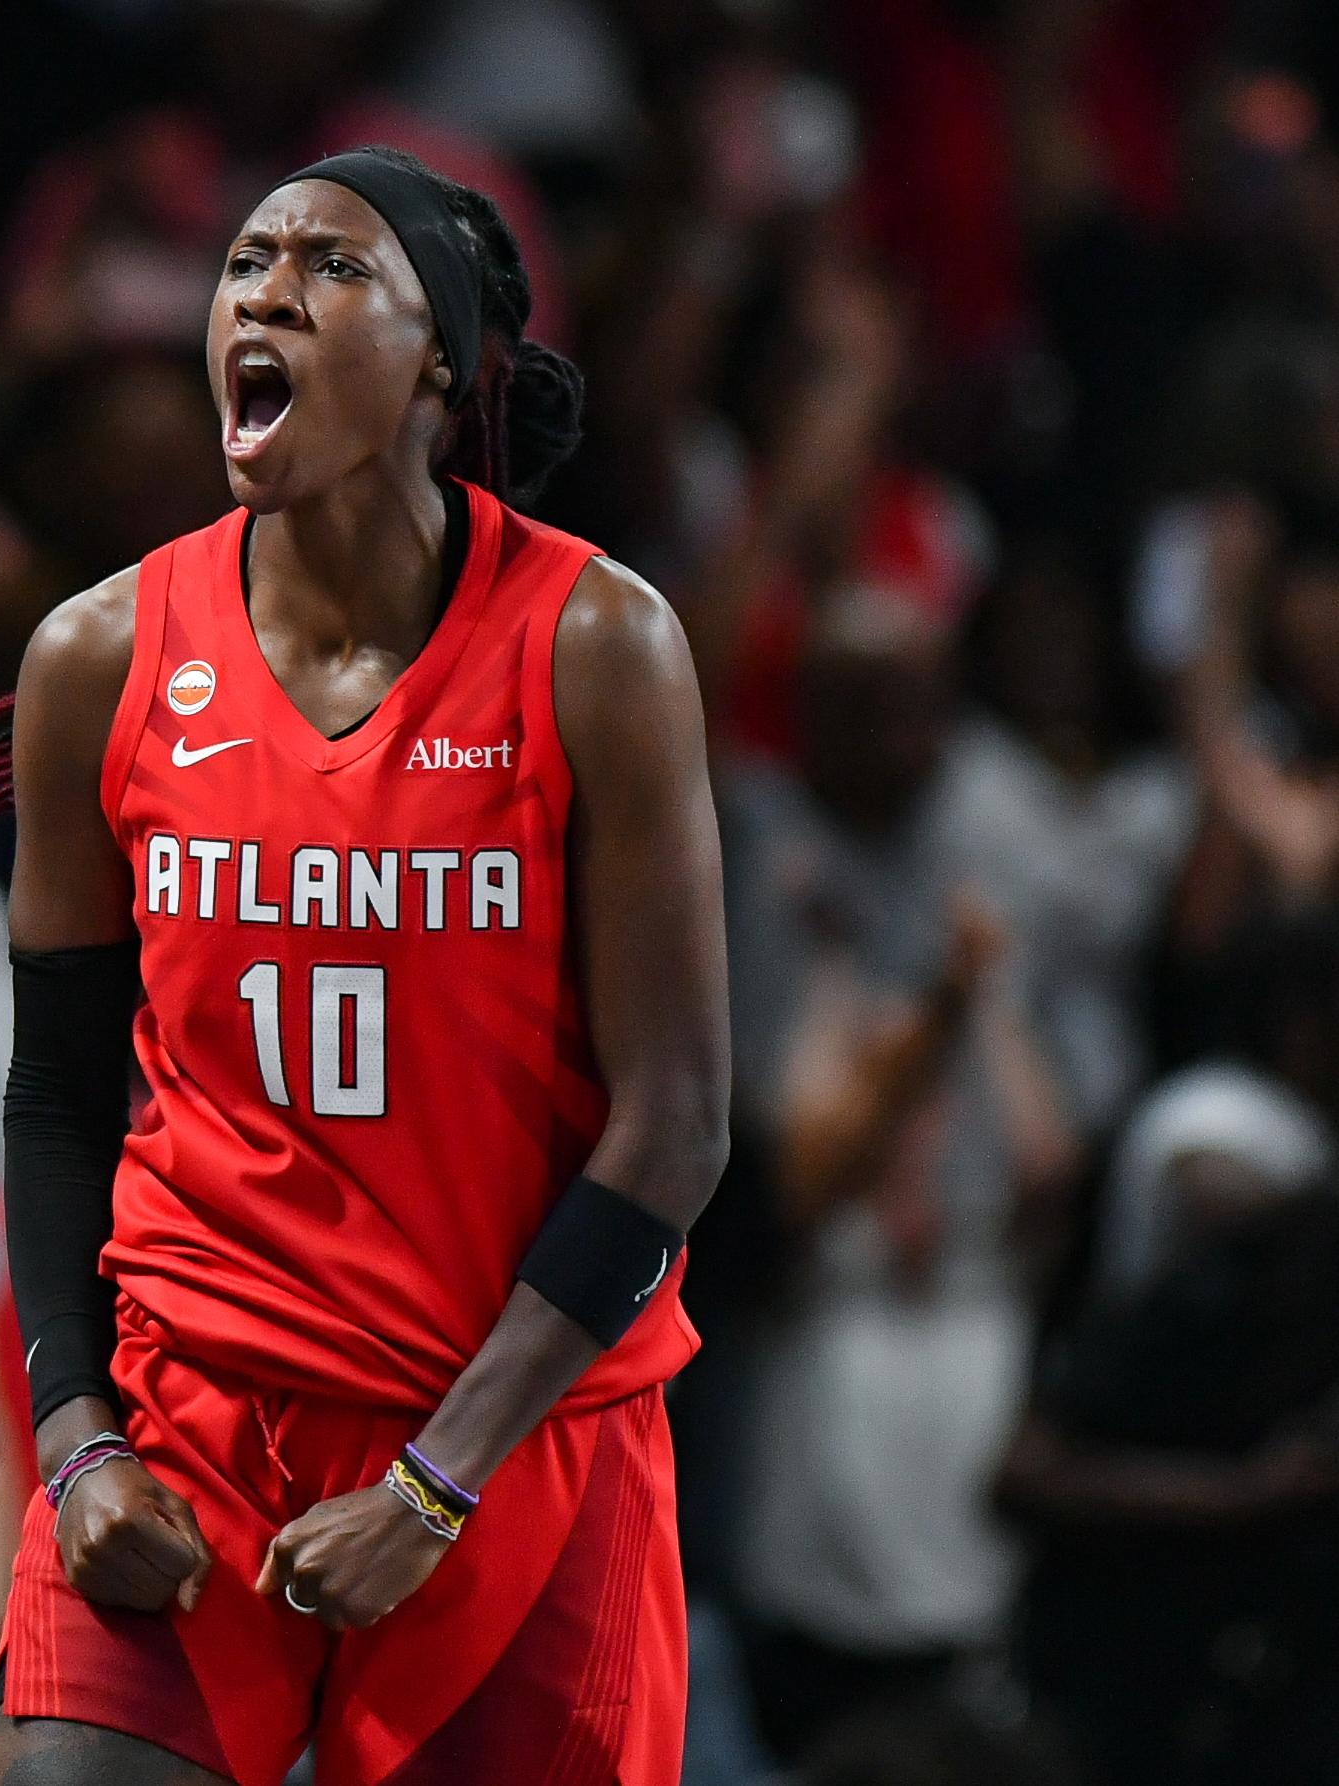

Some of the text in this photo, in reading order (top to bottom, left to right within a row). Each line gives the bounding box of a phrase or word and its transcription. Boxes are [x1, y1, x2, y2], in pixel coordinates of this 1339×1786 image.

[403, 737, 514, 770] Albert
[146, 833, 521, 932] ATLANTA
[238, 962, 385, 1117] 10
